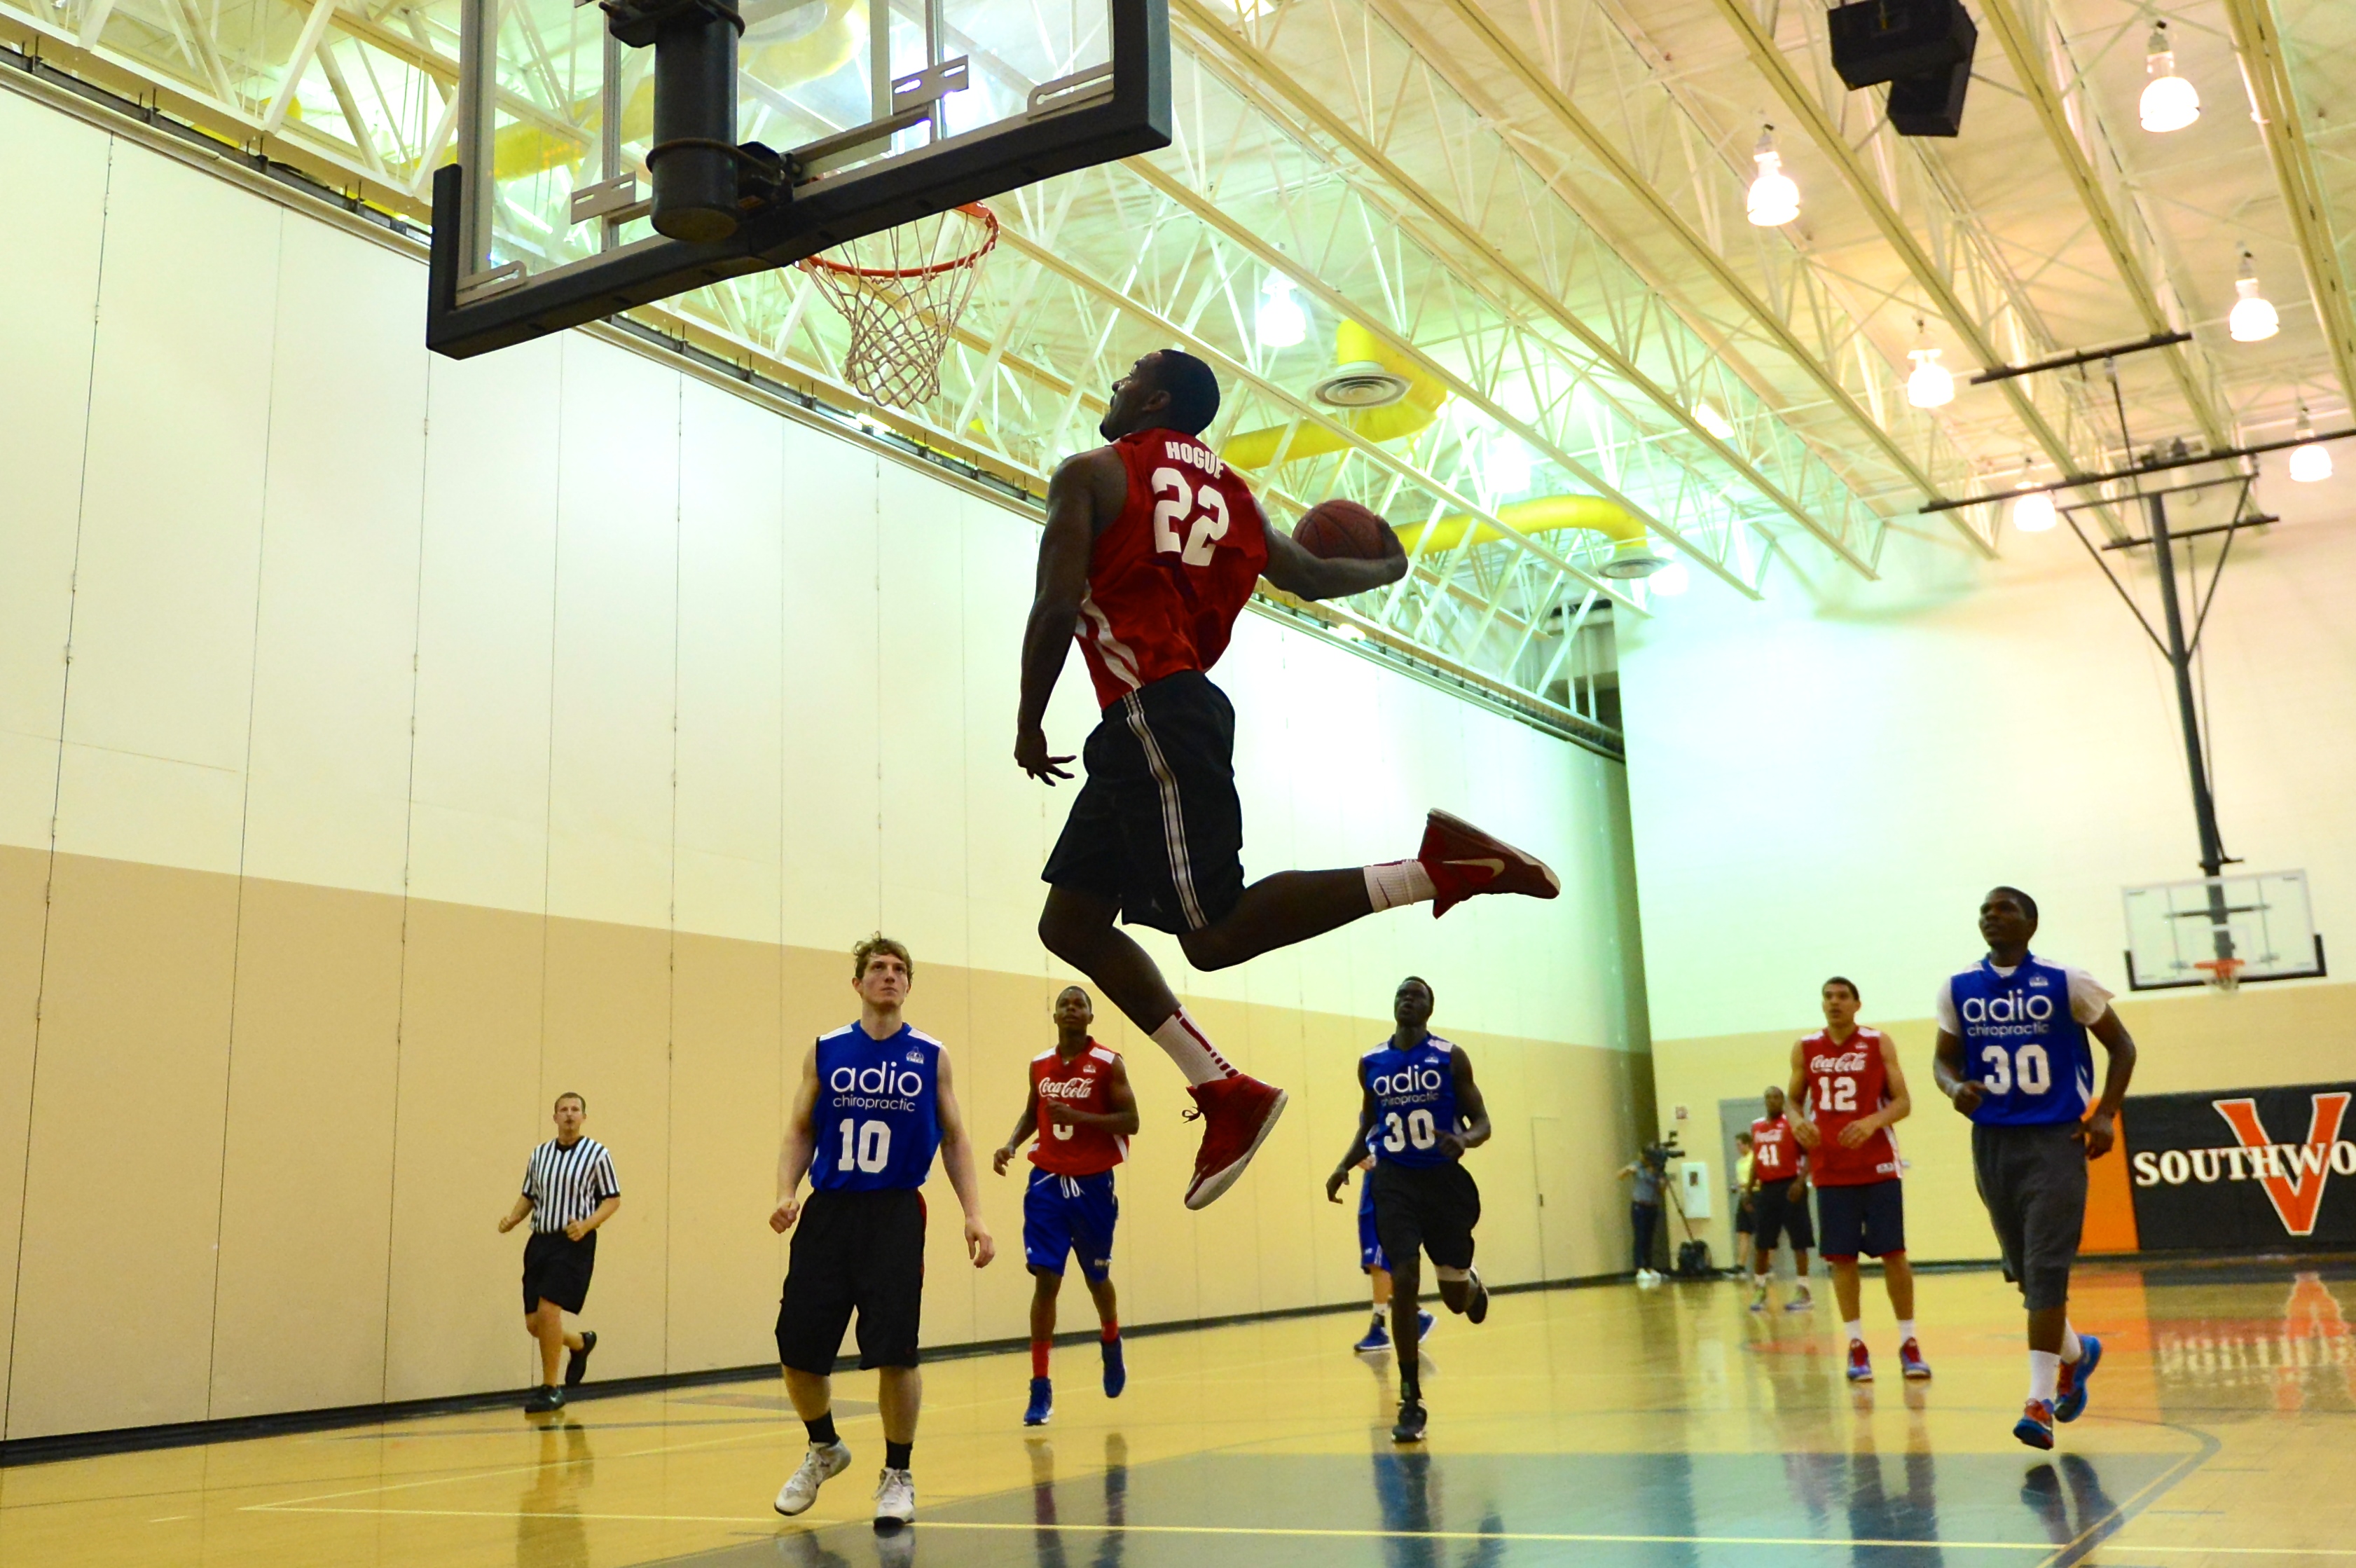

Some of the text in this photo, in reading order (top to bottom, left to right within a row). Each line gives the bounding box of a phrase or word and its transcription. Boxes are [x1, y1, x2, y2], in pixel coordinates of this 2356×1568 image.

[1165, 441, 1225, 479] HOGUE
[1151, 467, 1229, 567] 22
[1962, 988, 2053, 1023] adio
[1966, 1021, 2050, 1038] chiropractic
[830, 1061, 923, 1097] adio
[1372, 1064, 1442, 1096] adio
[1981, 1043, 2051, 1095] 30
[832, 1094, 916, 1113] chiropractic
[1818, 1076, 1857, 1111] 12
[838, 1118, 891, 1174] 10
[1383, 1108, 1436, 1153] 30
[1757, 1144, 1779, 1167] 41
